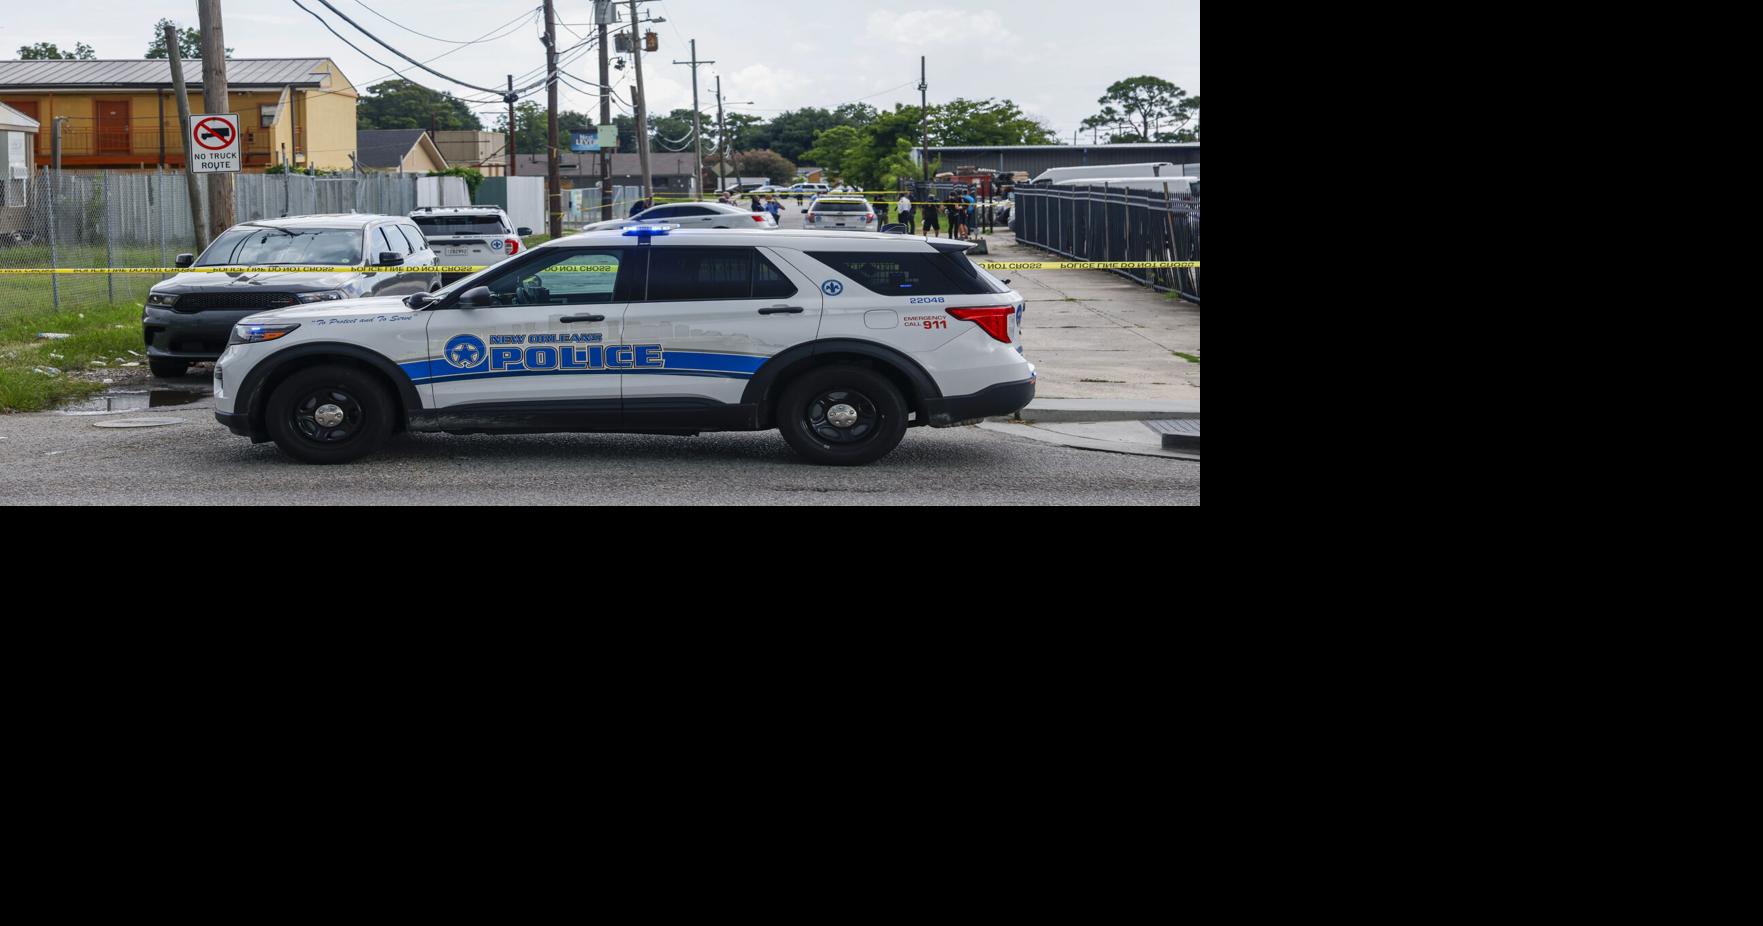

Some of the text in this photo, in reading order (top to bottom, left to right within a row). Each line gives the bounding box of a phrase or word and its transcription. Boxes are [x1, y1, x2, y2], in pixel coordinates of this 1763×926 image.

[201, 161, 231, 169] ROUTE
[923, 320, 947, 330] 911
[489, 333, 603, 345] NEW ORLEANS
[489, 343, 666, 371] POLICE
